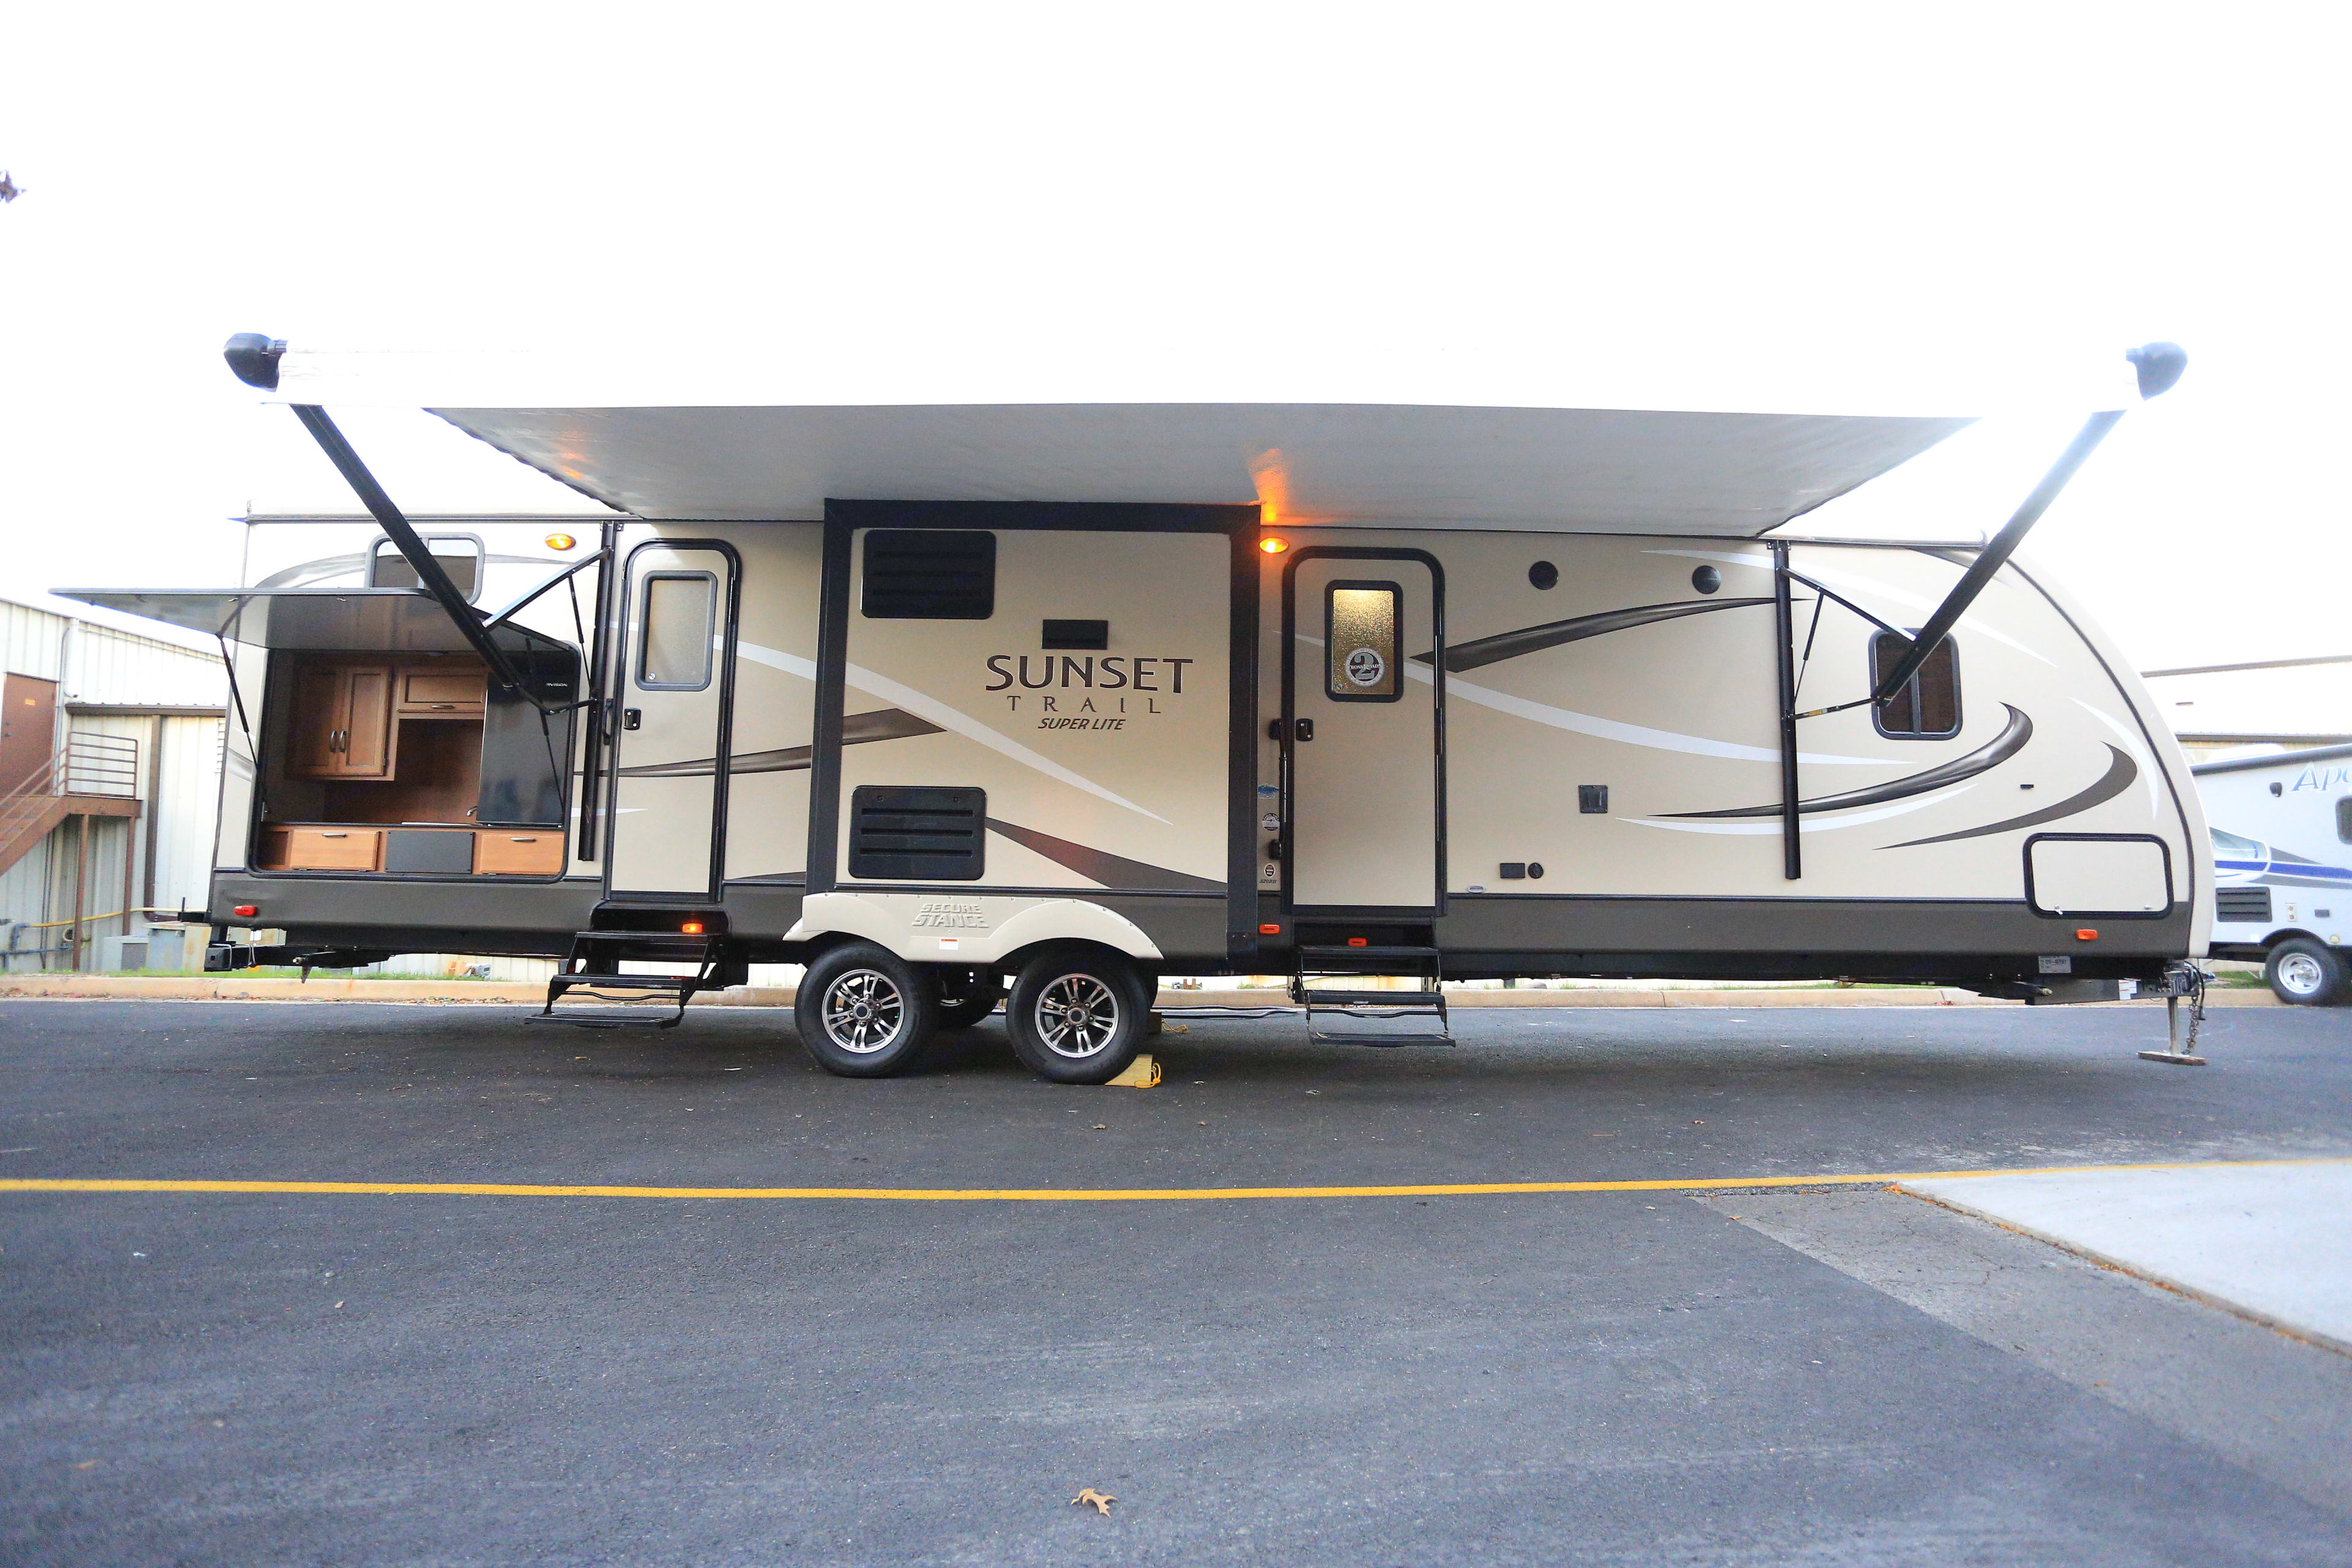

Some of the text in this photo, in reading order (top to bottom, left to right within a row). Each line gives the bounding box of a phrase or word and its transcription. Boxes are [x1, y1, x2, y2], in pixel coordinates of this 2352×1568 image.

[985, 655, 1194, 694] SUNSET
[1006, 695, 1161, 714] TRAIL
[1038, 717, 1126, 730] SUPER LITE
[920, 903, 982, 914] SECURE
[911, 914, 990, 929] STANCE
